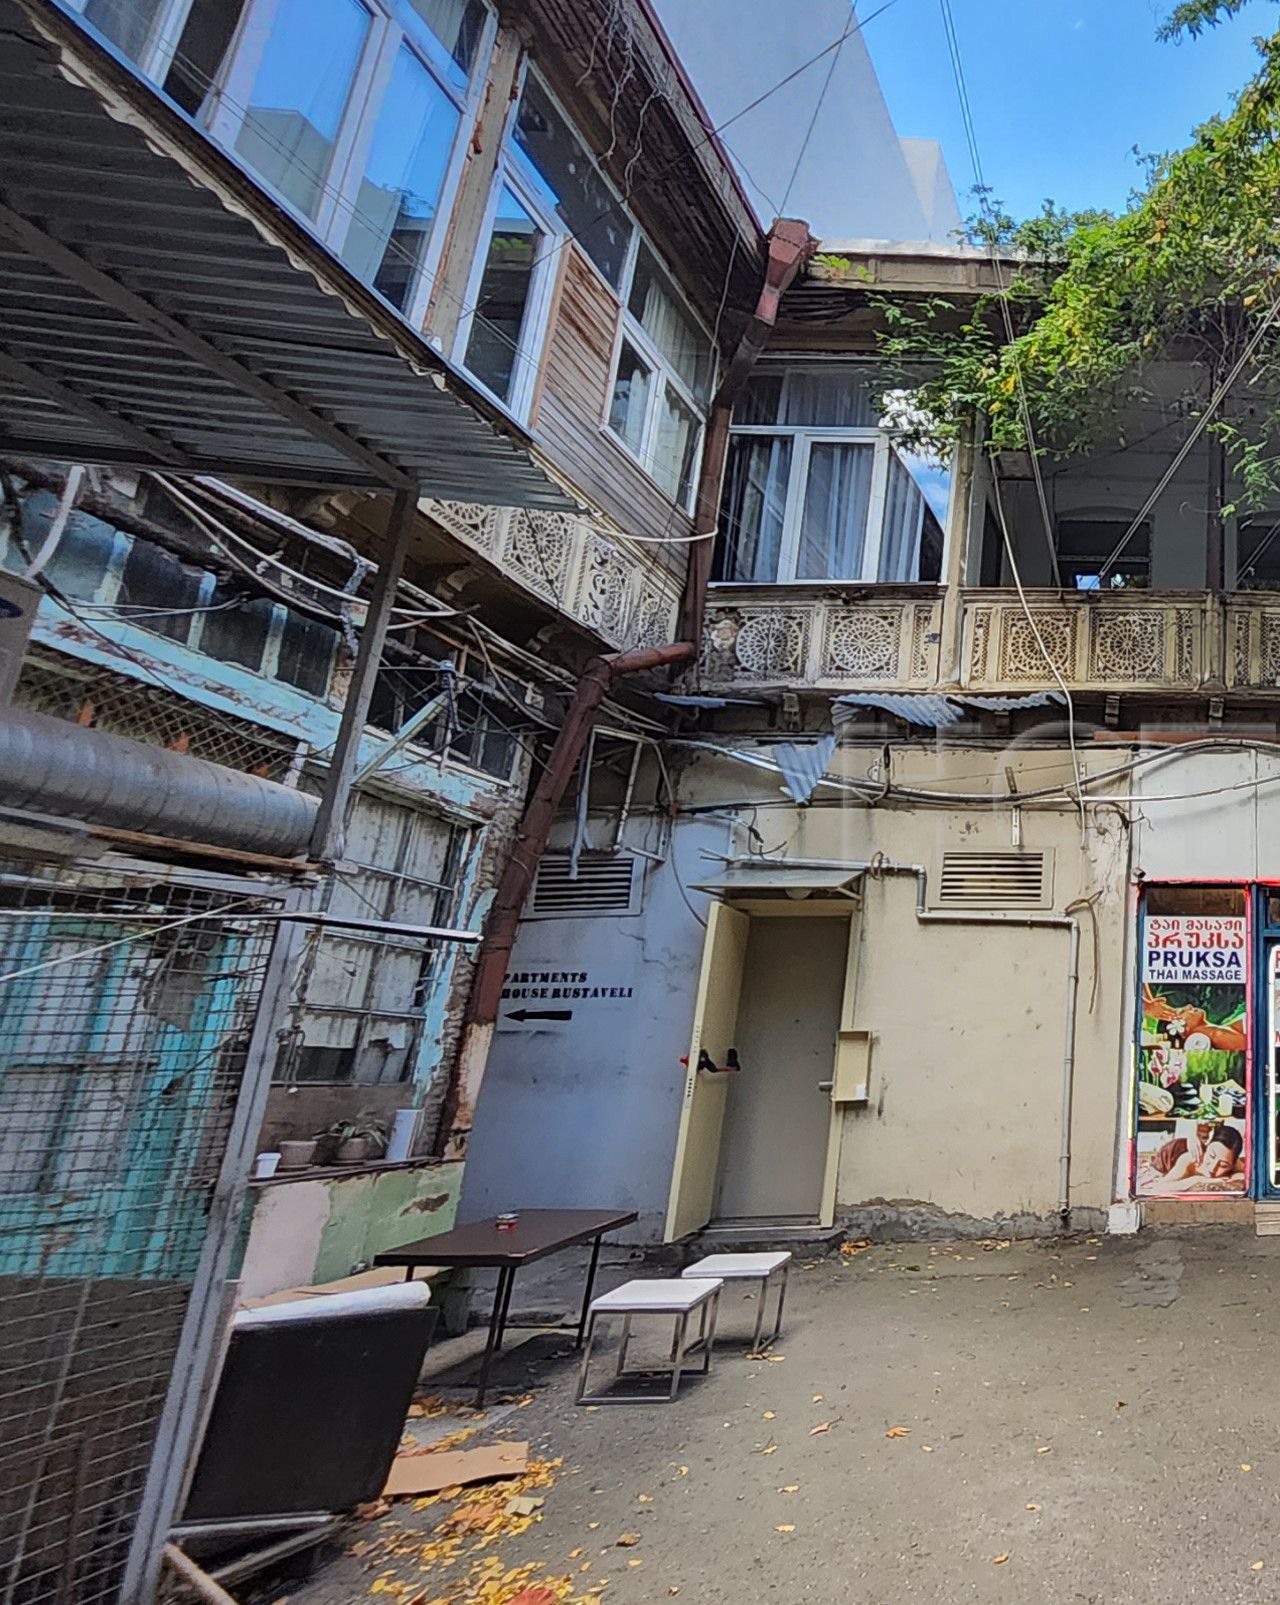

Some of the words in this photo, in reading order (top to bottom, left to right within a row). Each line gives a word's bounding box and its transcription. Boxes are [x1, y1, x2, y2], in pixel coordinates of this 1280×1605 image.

[1147, 931, 1244, 950] პრუკსა
[1148, 950, 1242, 968] PRUKSA
[1149, 969, 1178, 980] THAI
[1182, 969, 1241, 980] MASSAGE
[501, 988, 549, 999] HOUSE
[551, 987, 634, 999] RUSTAVELI
